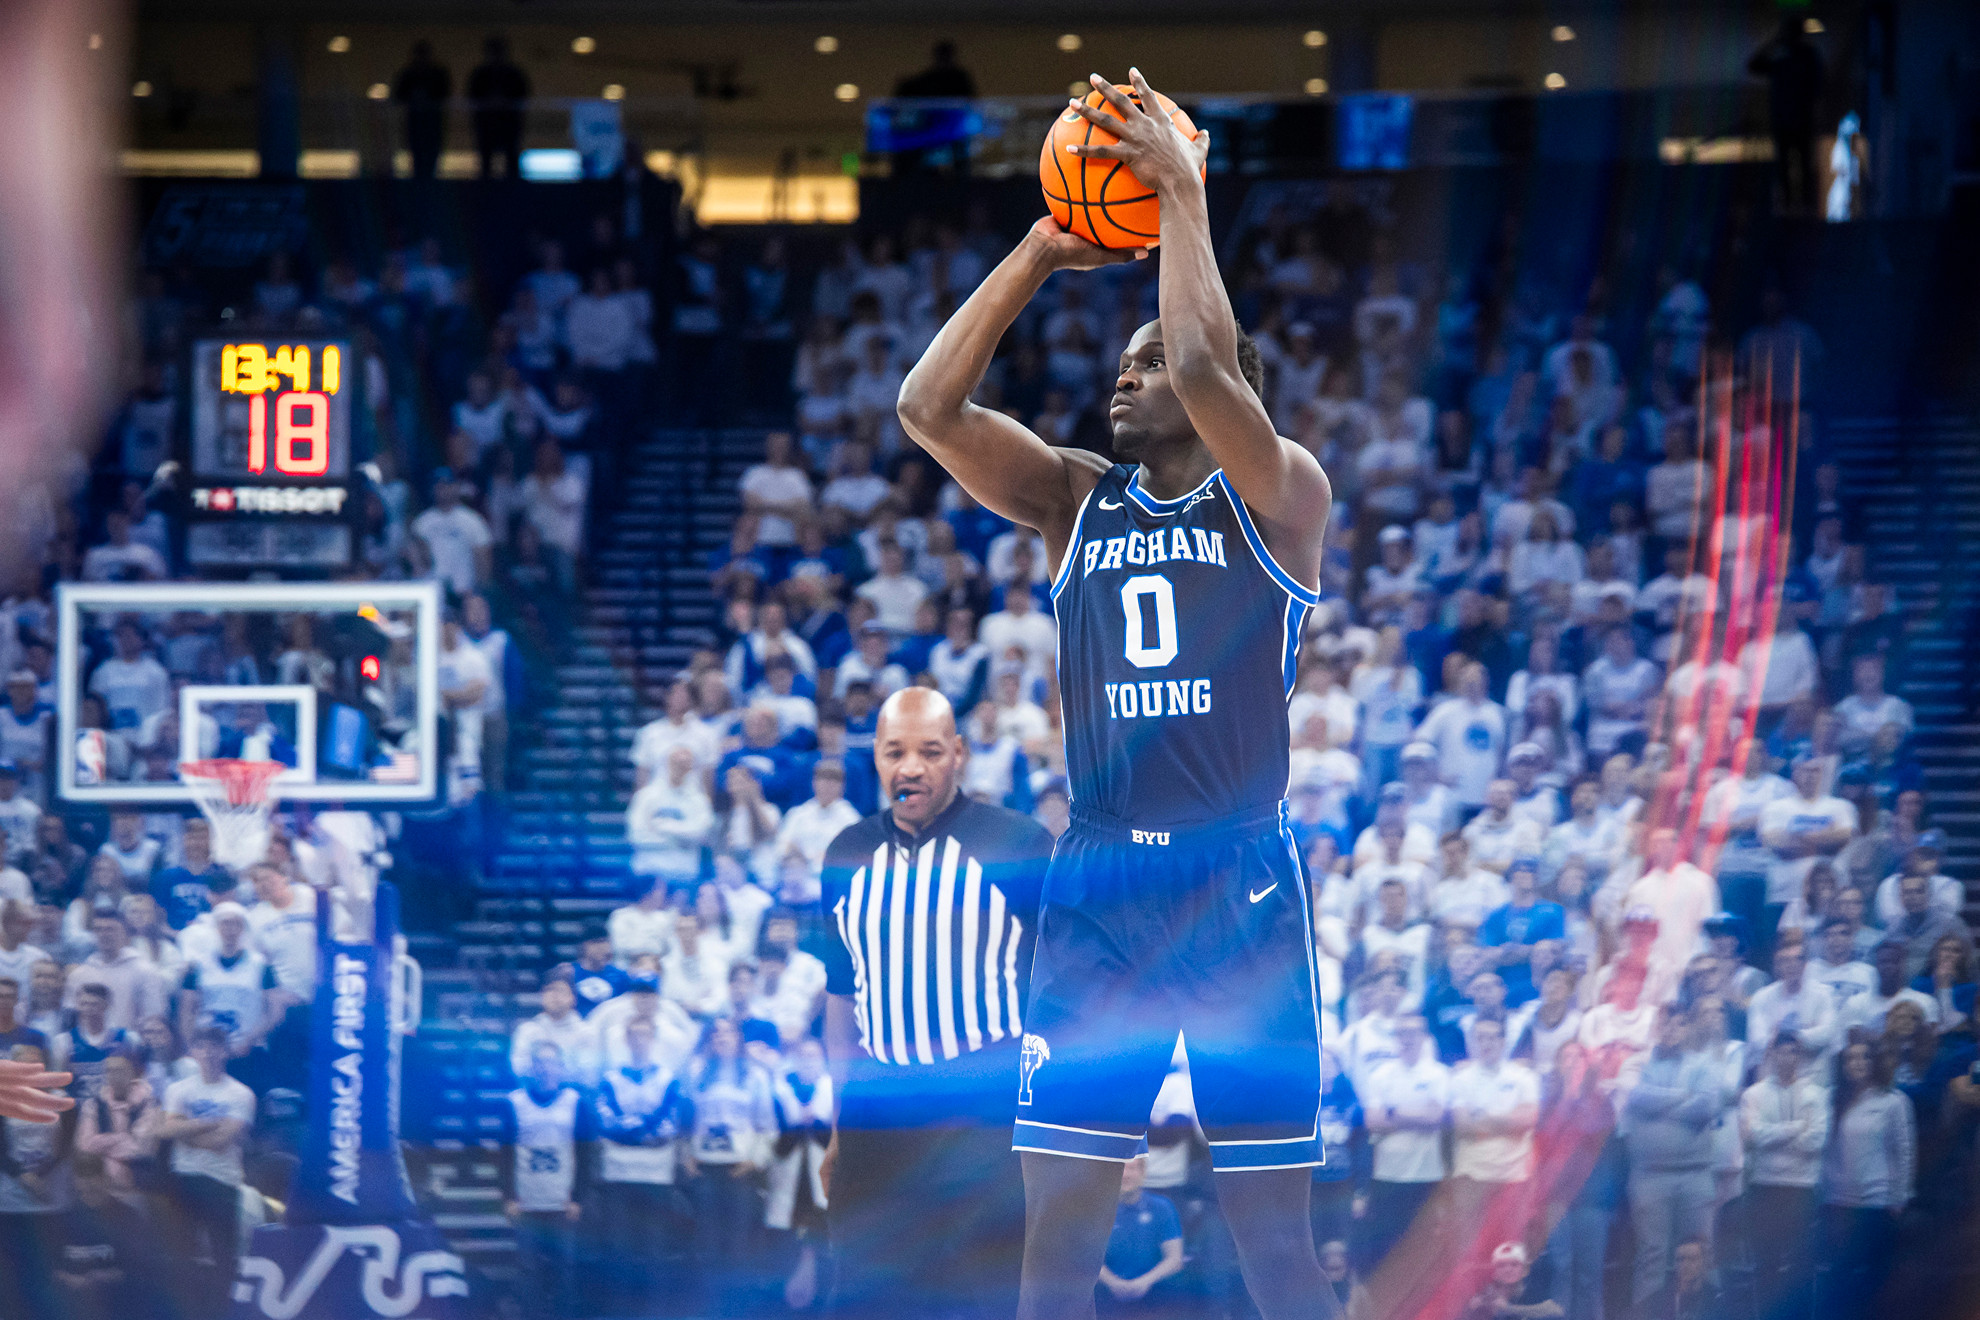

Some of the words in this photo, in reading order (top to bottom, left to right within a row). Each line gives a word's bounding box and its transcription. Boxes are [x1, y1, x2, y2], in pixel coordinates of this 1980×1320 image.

[221, 344, 341, 395] 13:41
[248, 391, 330, 476] 18
[236, 487, 347, 514] TISSOT
[1083, 526, 1228, 580] BRGHAM
[1120, 573, 1179, 669] 0
[1105, 678, 1211, 719] YOUNG
[1131, 829, 1170, 845] BYU
[332, 953, 367, 1050] FIRST
[327, 1052, 364, 1206] AMERICA
